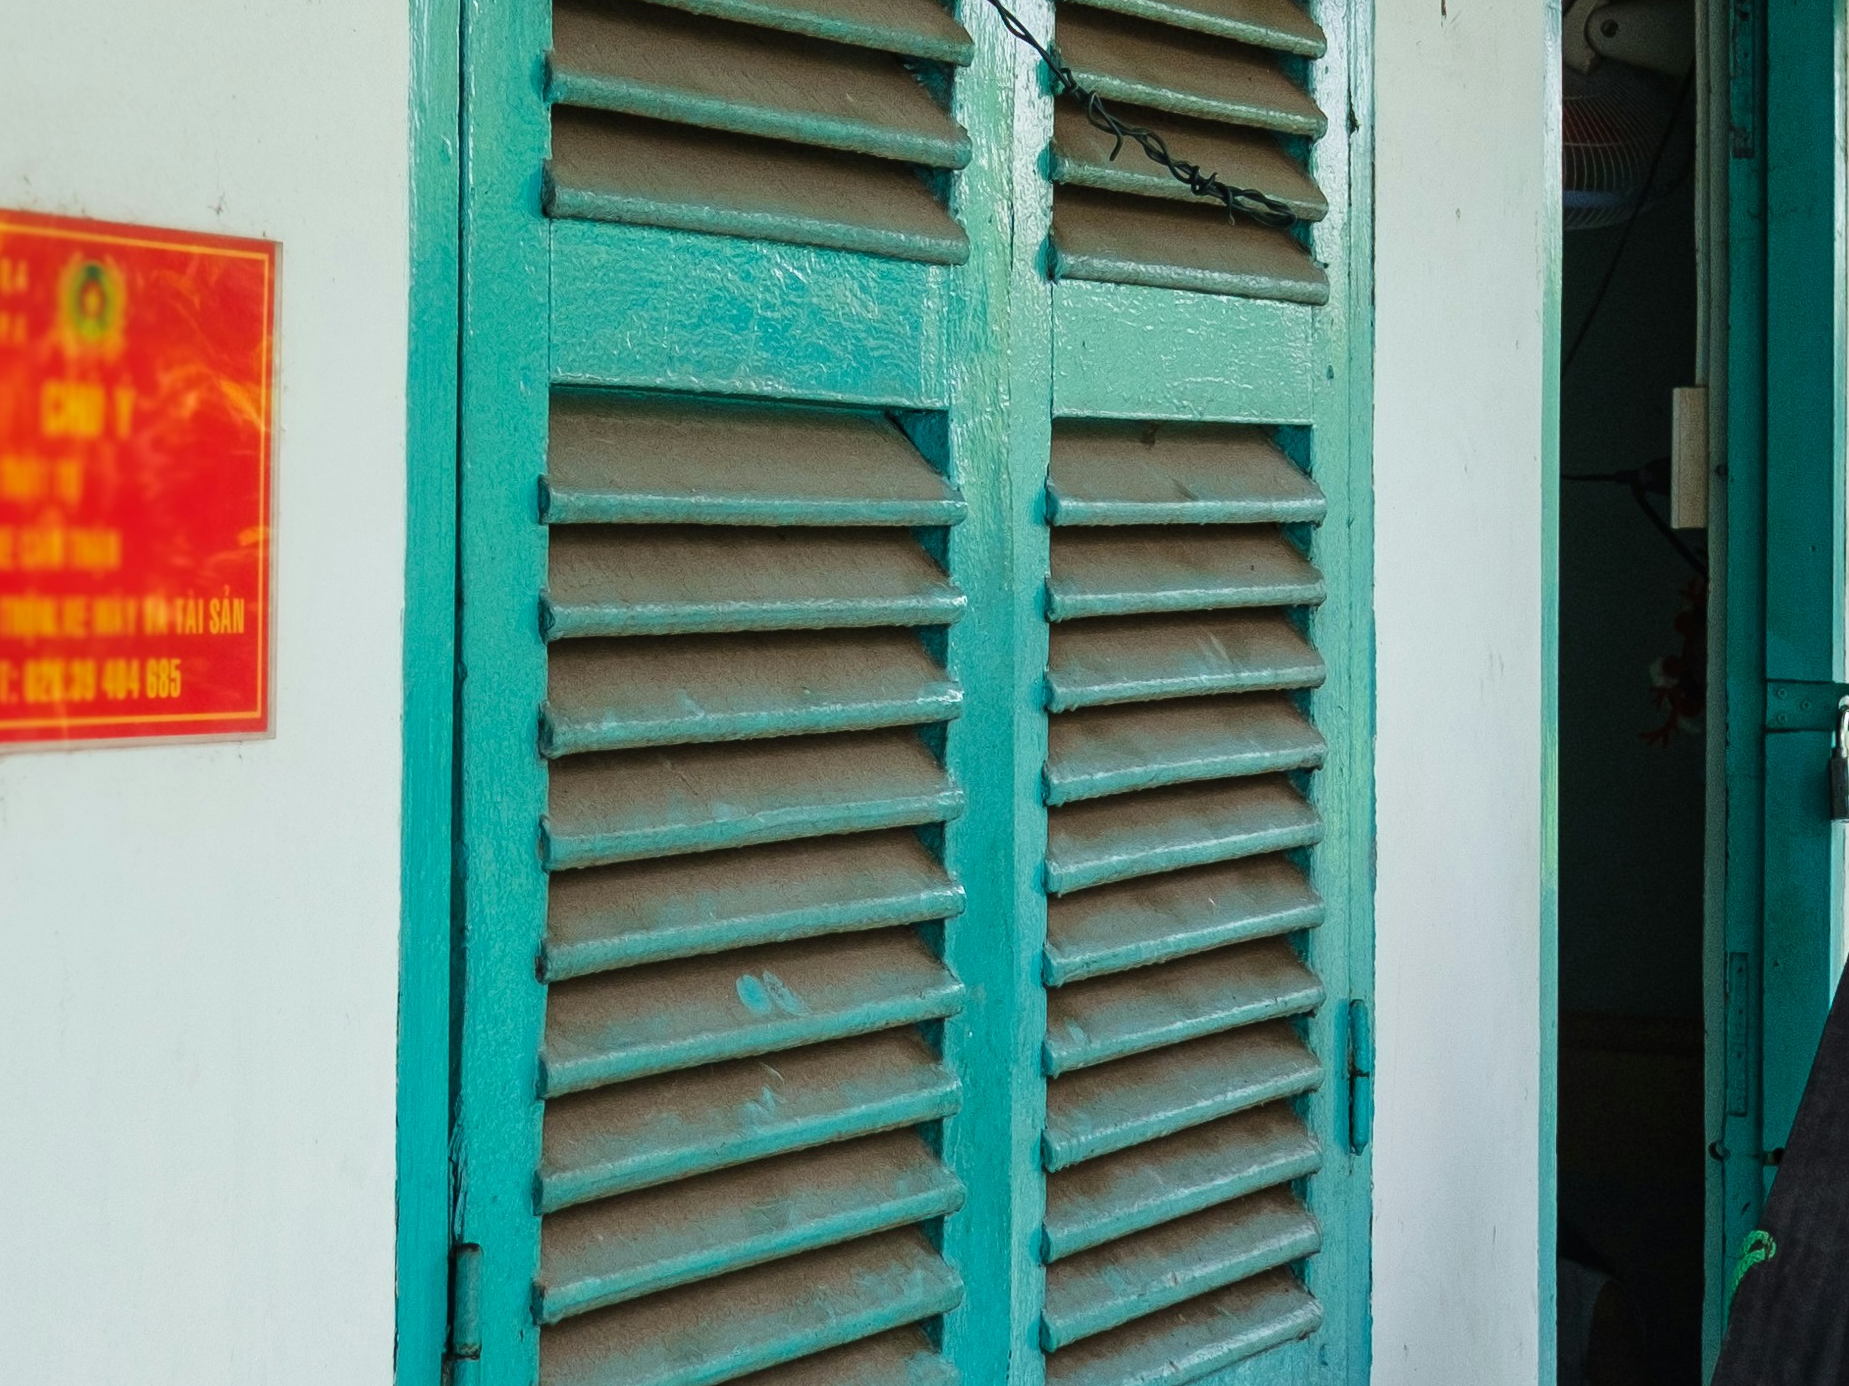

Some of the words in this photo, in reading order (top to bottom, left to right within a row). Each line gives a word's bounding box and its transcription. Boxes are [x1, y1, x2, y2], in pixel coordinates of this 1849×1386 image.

[174, 589, 204, 635] TÀI
[209, 584, 246, 635] SẢN
[146, 658, 182, 699] 685
